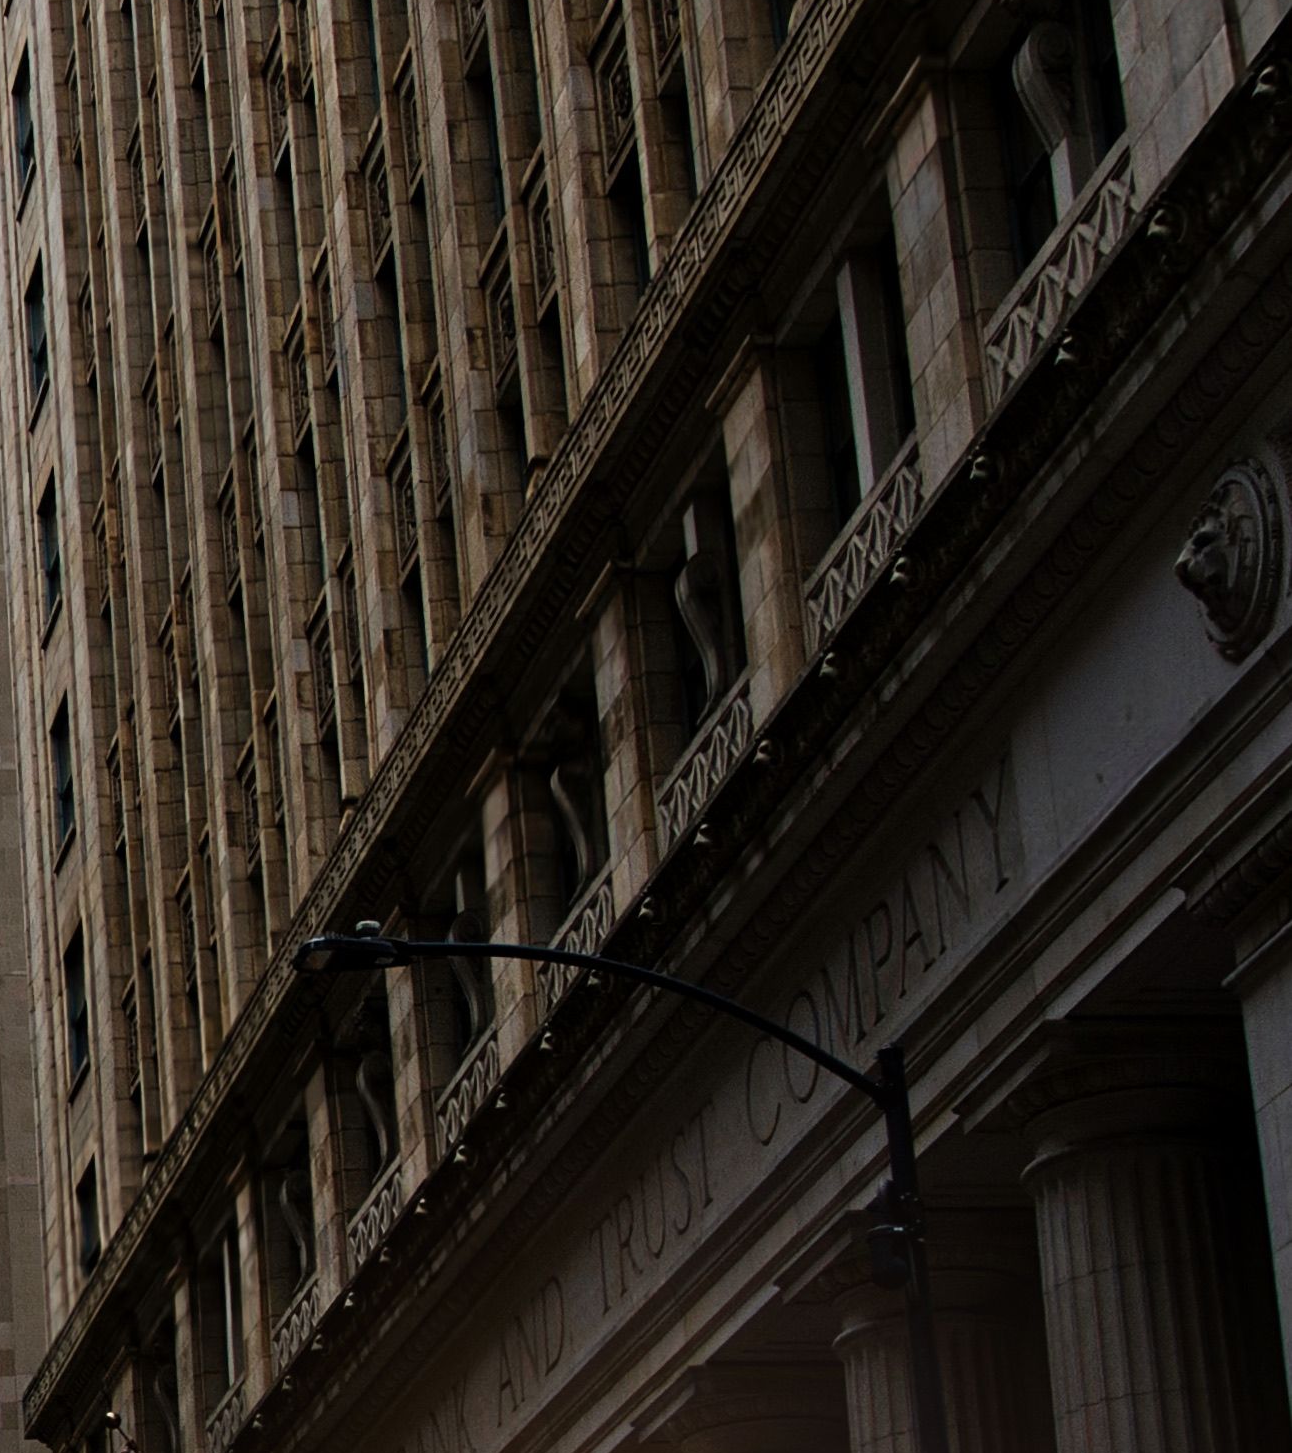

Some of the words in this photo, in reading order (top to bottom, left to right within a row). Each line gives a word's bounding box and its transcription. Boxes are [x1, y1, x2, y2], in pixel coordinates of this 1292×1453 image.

[496, 1274, 567, 1429] AND
[589, 1097, 715, 1318] TRUST
[745, 755, 1012, 1147] COMPANY
